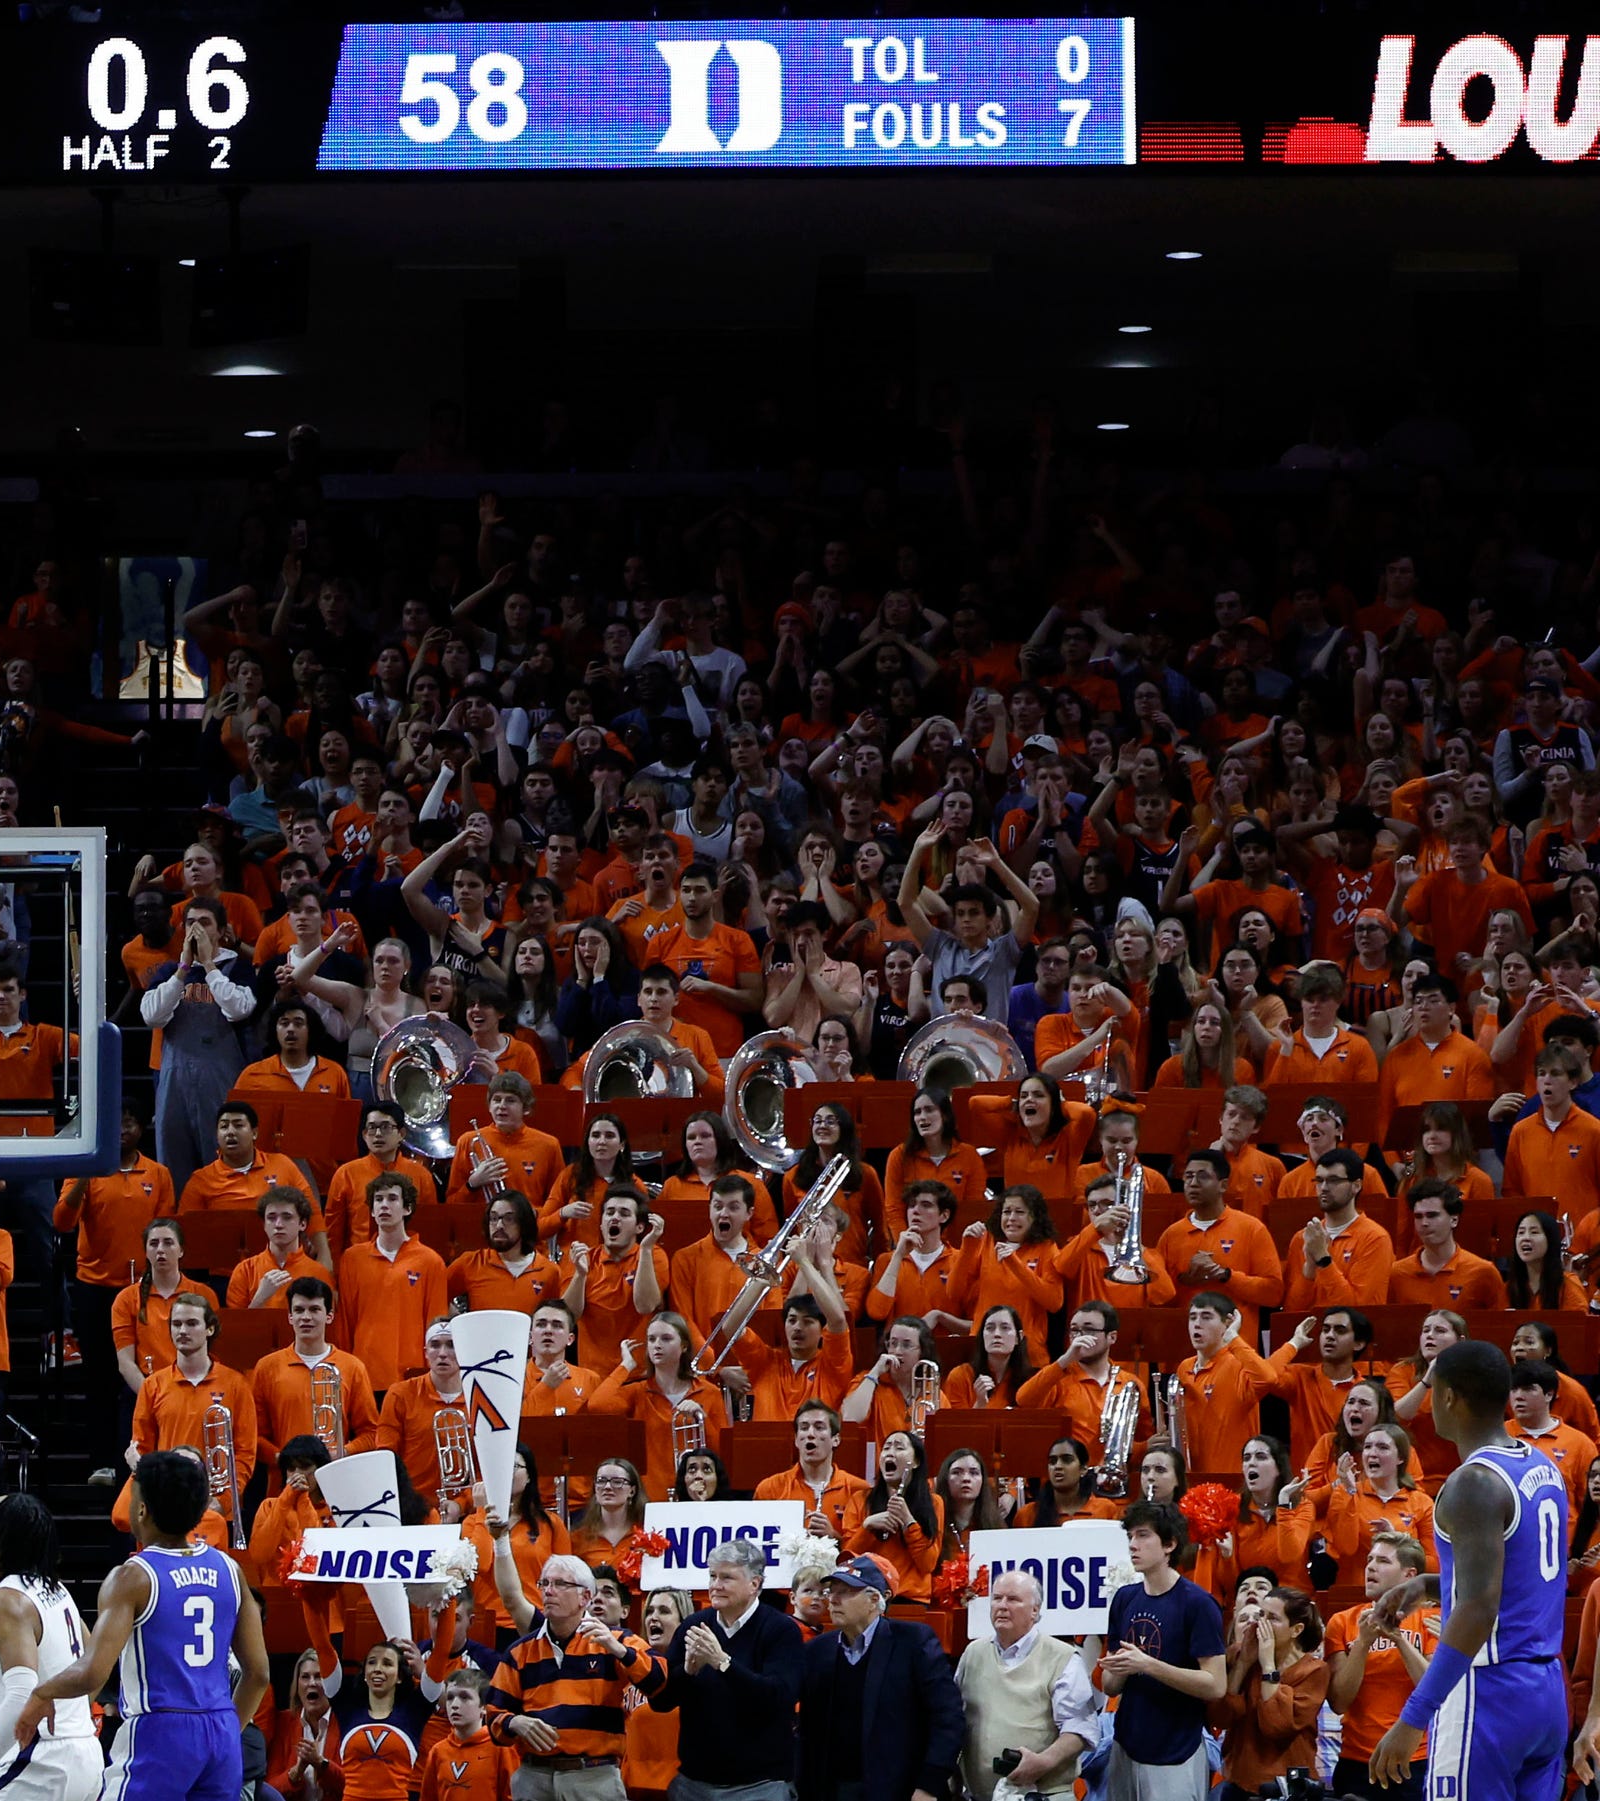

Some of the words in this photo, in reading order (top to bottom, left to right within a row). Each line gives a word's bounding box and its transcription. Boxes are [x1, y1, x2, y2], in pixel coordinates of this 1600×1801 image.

[87, 36, 250, 131] 0.6
[843, 36, 939, 84] TOL
[1056, 36, 1091, 84] 0
[400, 52, 528, 143] 58
[843, 102, 1008, 149] FOULS
[1059, 99, 1091, 147] 7
[63, 135, 170, 171] HALF
[208, 137, 231, 169] 2
[663, 1525, 781, 1569] NOE
[1537, 1497, 1560, 1583] 0
[169, 1566, 218, 1589] ROACH
[991, 1555, 1107, 1610] ISE
[183, 1595, 215, 1668] 3
